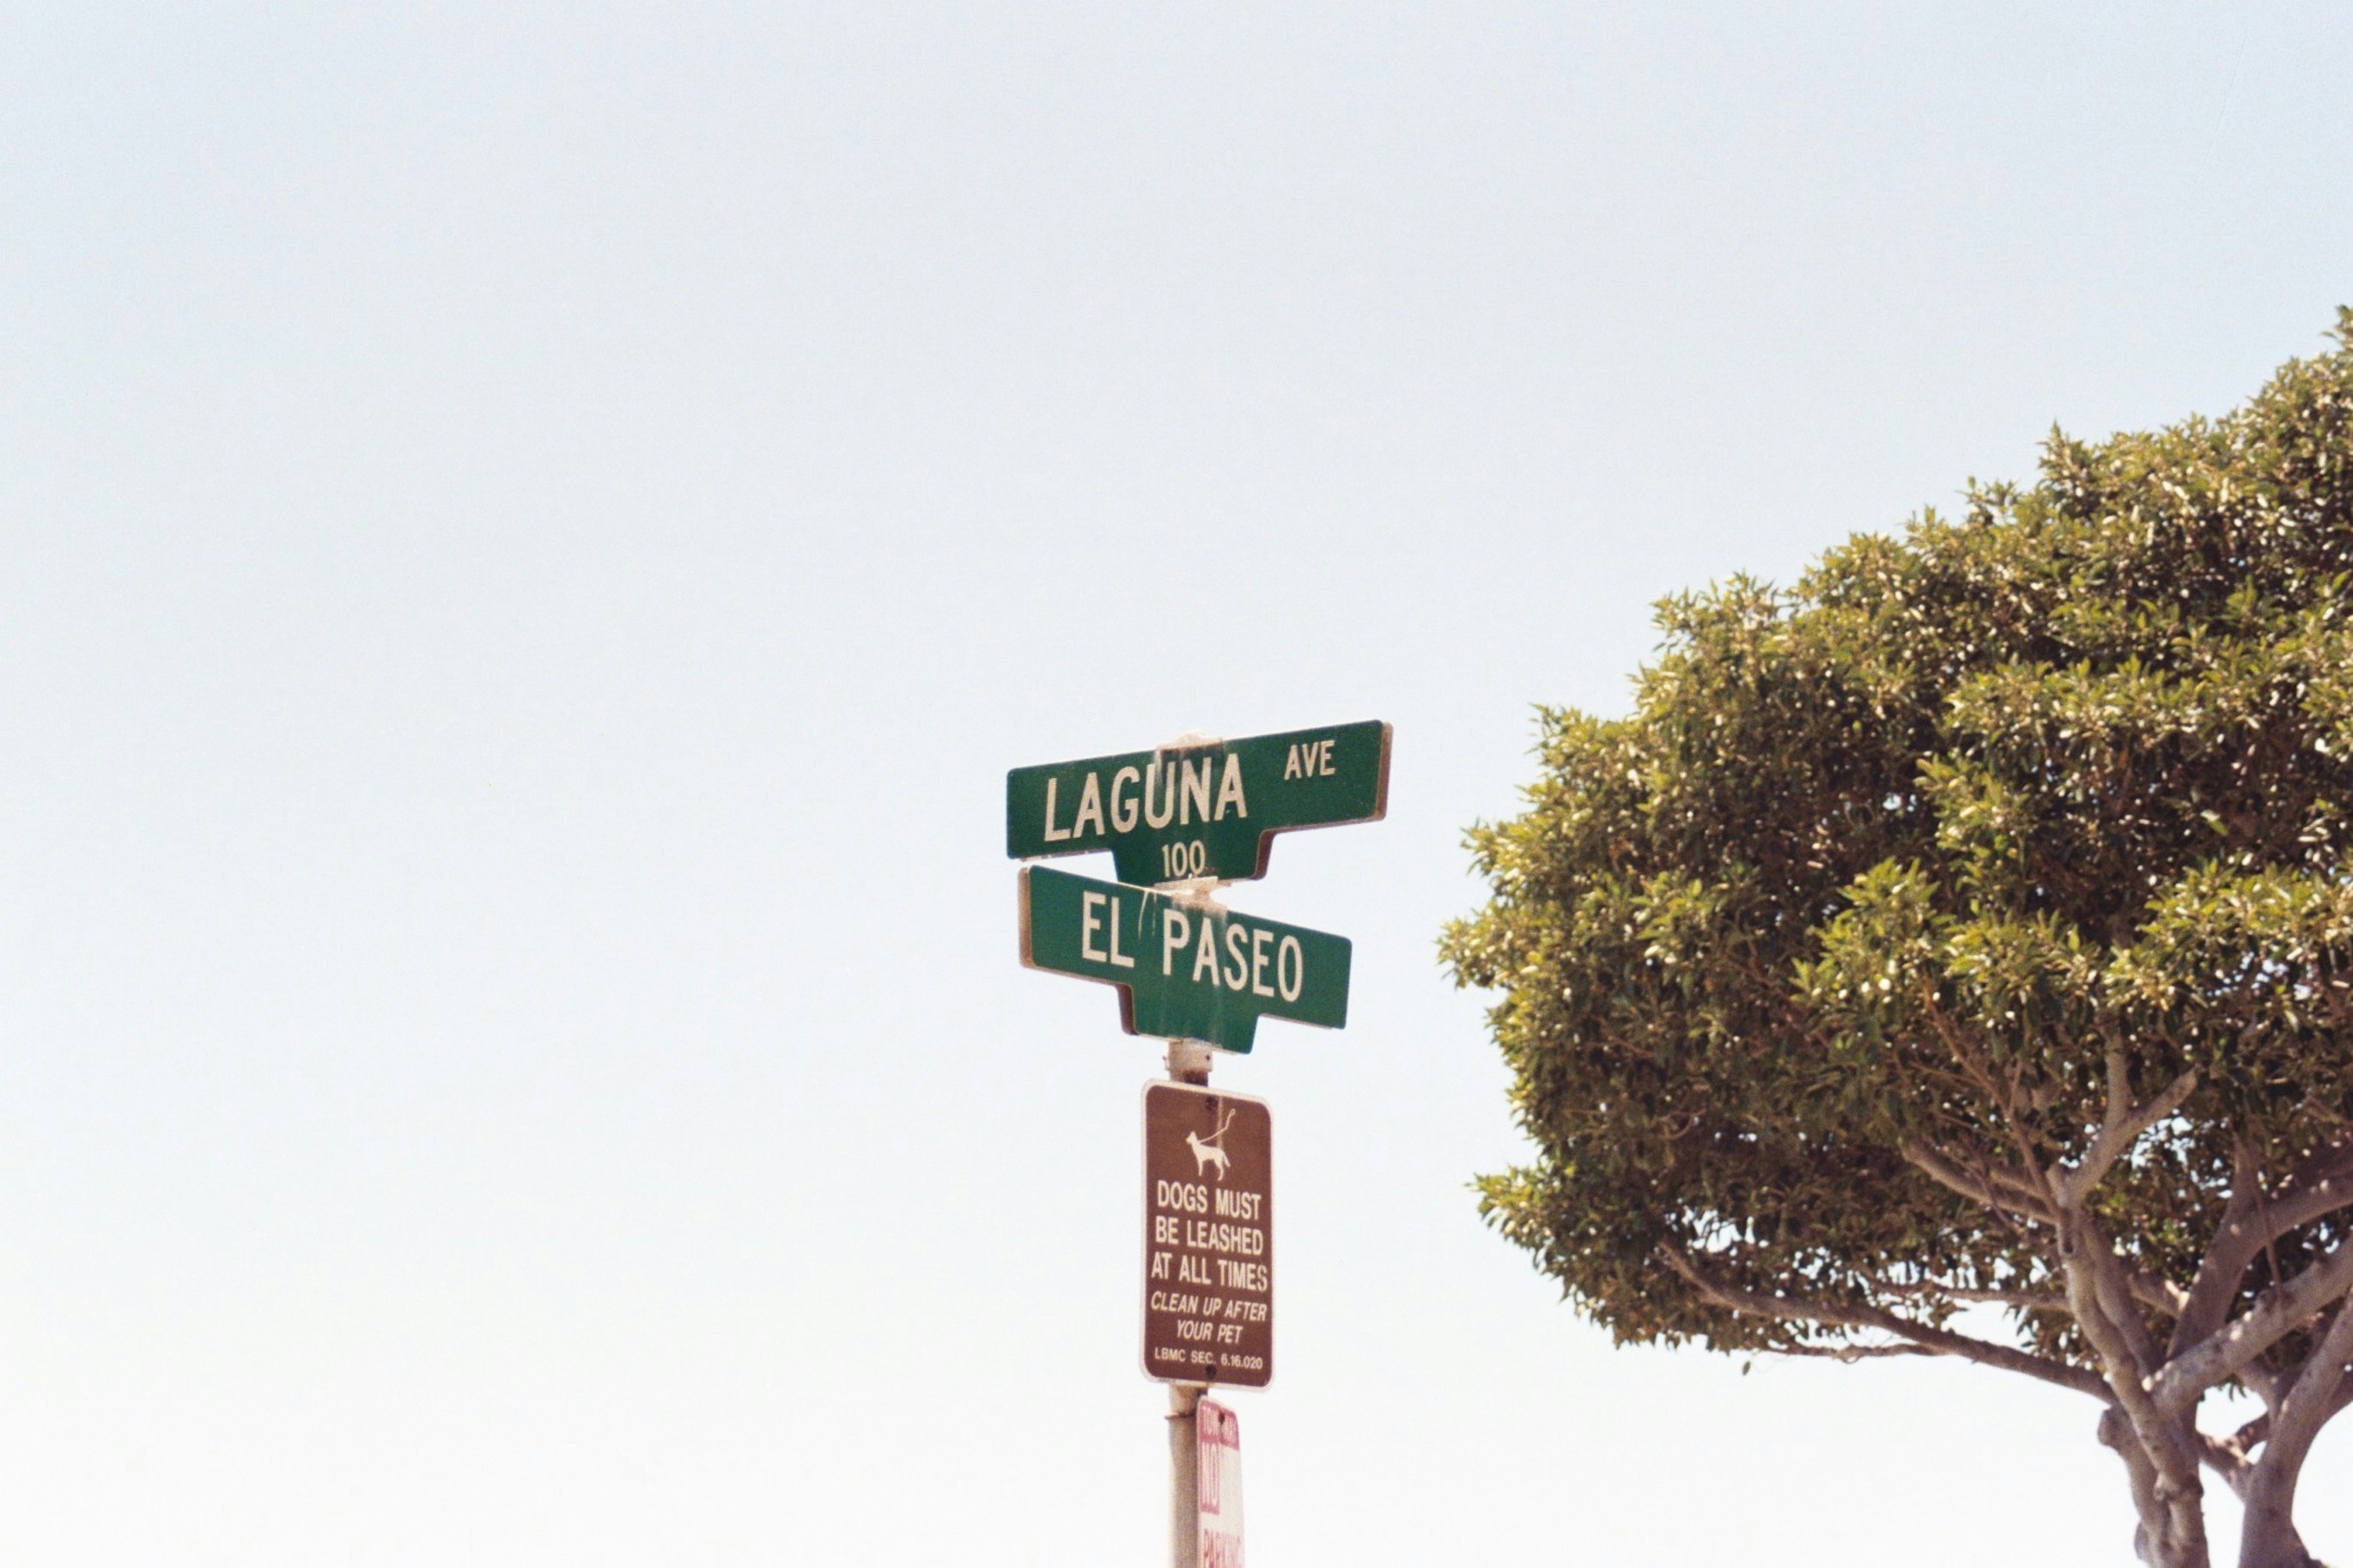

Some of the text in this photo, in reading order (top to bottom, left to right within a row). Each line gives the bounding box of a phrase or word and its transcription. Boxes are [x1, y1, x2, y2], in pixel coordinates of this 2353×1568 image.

[1043, 740, 1335, 842] LAGUNA AVE
[1162, 839, 1206, 877] 100
[1082, 890, 1304, 1002] EL PASEO
[1158, 1180, 1262, 1220] DOGS MUST
[1156, 1216, 1263, 1255] BE LEASHED
[1151, 1252, 1268, 1293] AT ALL TIMES
[1151, 1291, 1268, 1322] CLEAN UP AFTER
[1176, 1320, 1243, 1344] YOUR PET
[1154, 1347, 1263, 1370] LBMC SEC. 6.16.020
